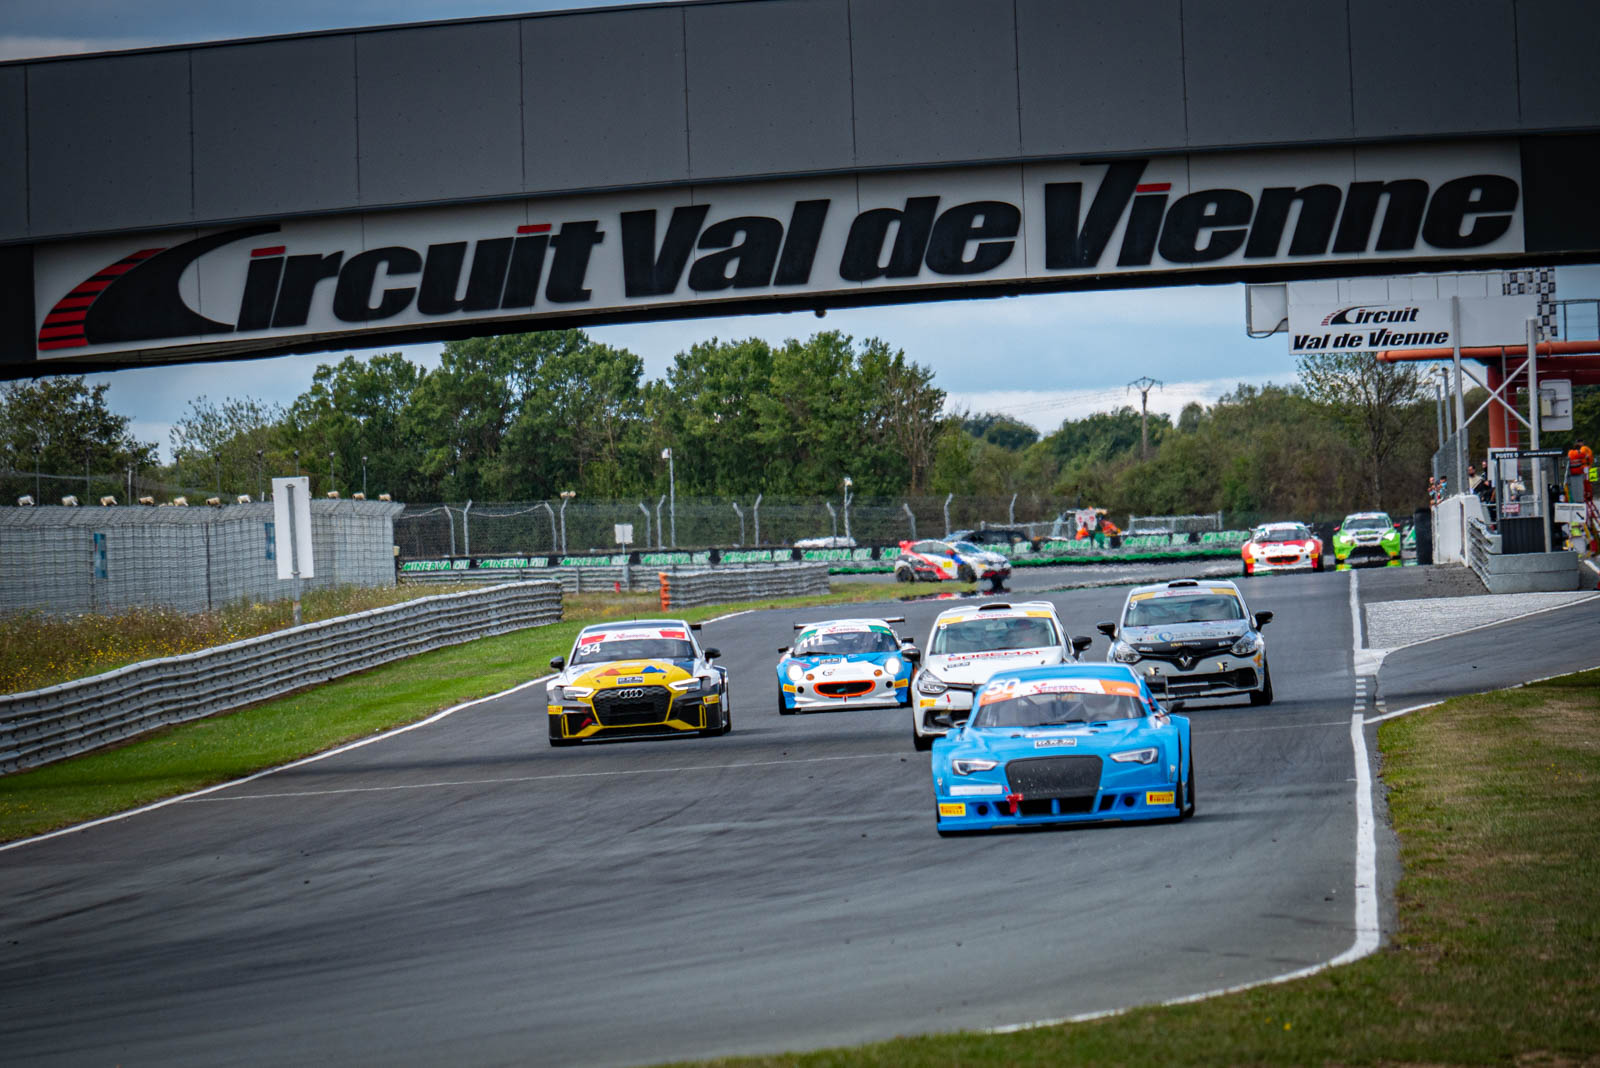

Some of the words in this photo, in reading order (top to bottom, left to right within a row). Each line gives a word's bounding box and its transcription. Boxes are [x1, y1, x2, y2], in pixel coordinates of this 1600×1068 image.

[84, 219, 606, 344] Circuit
[620, 199, 830, 298] Val
[839, 196, 1022, 282] de
[1044, 160, 1519, 270] Vienne
[1330, 304, 1419, 325] Circuit
[1293, 334, 1329, 350] Val
[1333, 333, 1363, 348] de
[1368, 328, 1449, 347] Vienne
[402, 560, 451, 572] MINERVA
[479, 558, 528, 569] MINERVA
[579, 643, 601, 656] 34
